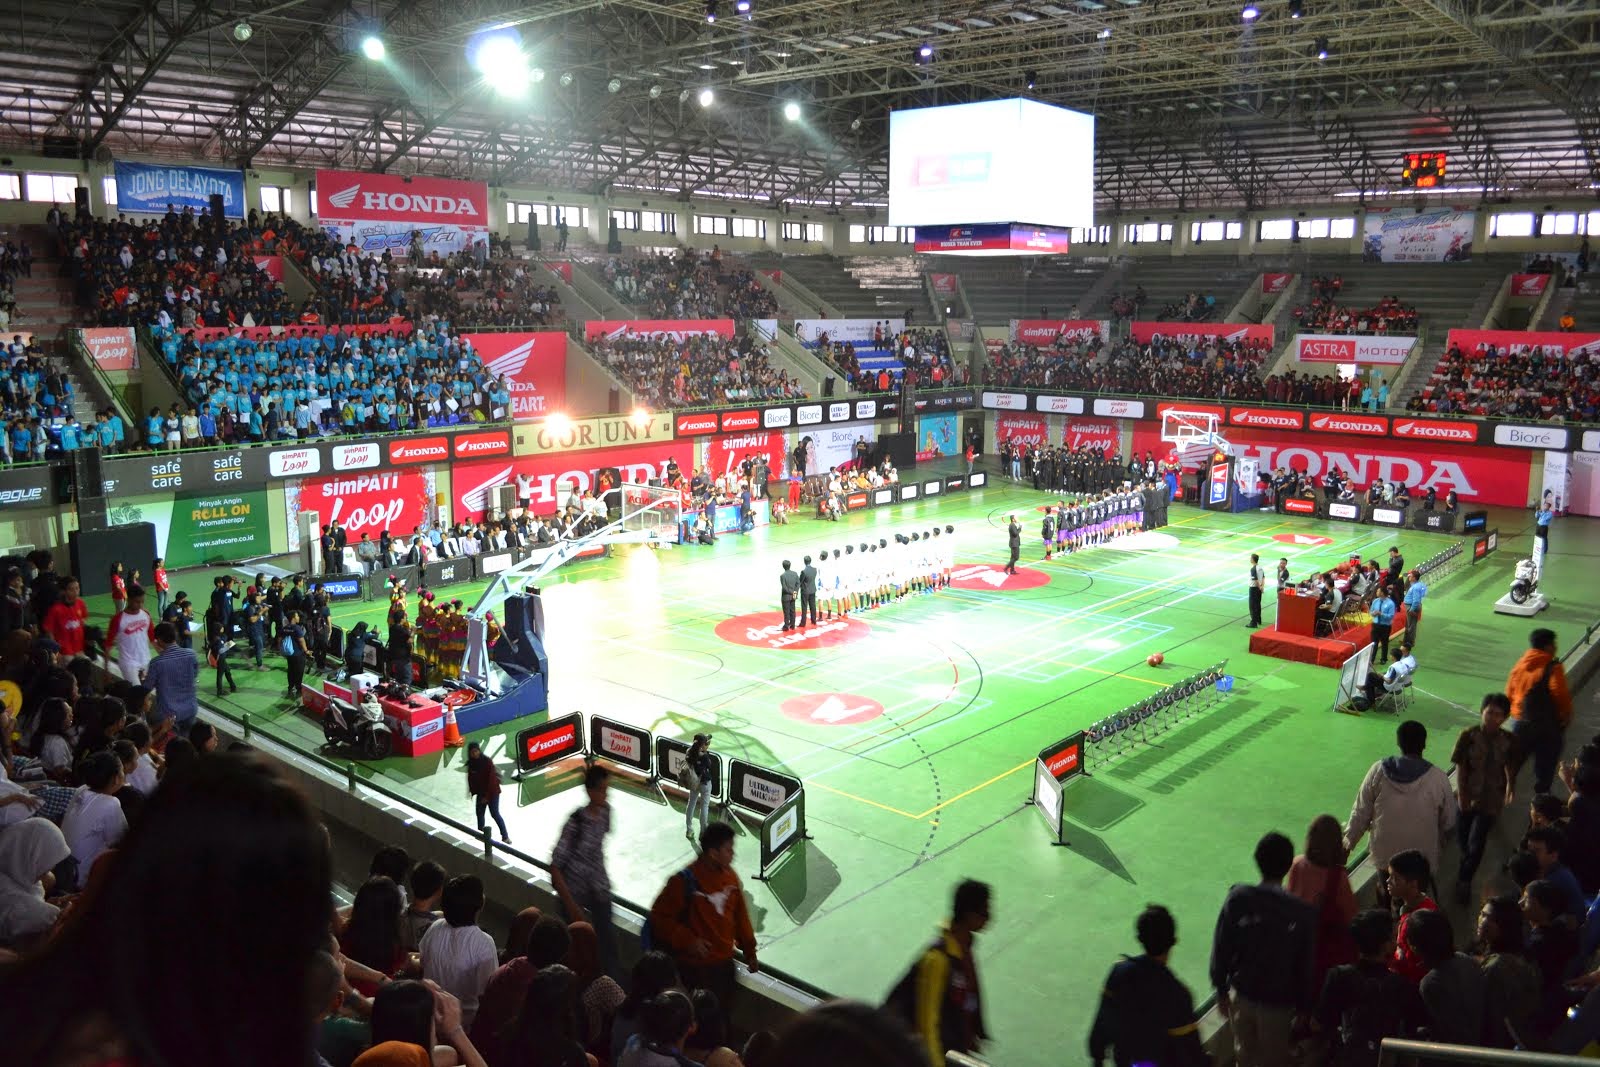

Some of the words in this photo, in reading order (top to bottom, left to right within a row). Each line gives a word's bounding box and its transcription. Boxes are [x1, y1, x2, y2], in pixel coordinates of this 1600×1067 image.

[128, 170, 164, 196] JONG
[362, 192, 478, 216] HONDA
[94, 344, 128, 360] Loop
[1303, 342, 1348, 357] ASTRA
[1359, 347, 1409, 356] MOTOR
[731, 417, 758, 426] HONDA
[767, 412, 789, 423] Bioré
[799, 410, 820, 421] Bioré
[1247, 415, 1298, 427] HONDA
[687, 420, 716, 431] HONDA
[1328, 421, 1384, 433] HONDA
[1412, 427, 1473, 440] HONDA
[1510, 429, 1551, 445] Bioré
[405, 445, 447, 457] HONDA
[468, 440, 507, 451] HONDA
[213, 455, 242, 469] safe
[281, 459, 309, 473] Loop
[343, 454, 369, 467] Loop
[152, 461, 181, 475] safe
[214, 468, 243, 482] care
[1231, 444, 1478, 496] HONDA
[152, 476, 182, 489] care
[322, 472, 399, 497] simPATI
[0, 487, 42, 504] ague
[199, 499, 224, 509] Minyak
[225, 497, 243, 506] Angin
[192, 507, 228, 520] ROLL
[231, 504, 251, 515] ON
[330, 497, 404, 532] Loop
[199, 516, 246, 528] Aromatherapy
[193, 534, 255, 549] www.safecare.co.id
[540, 732, 575, 751] HONDA
[609, 738, 632, 756] Loop
[1052, 753, 1077, 771] HONDA
[749, 779, 769, 793] ULTRA
[750, 789, 766, 801] MILK
